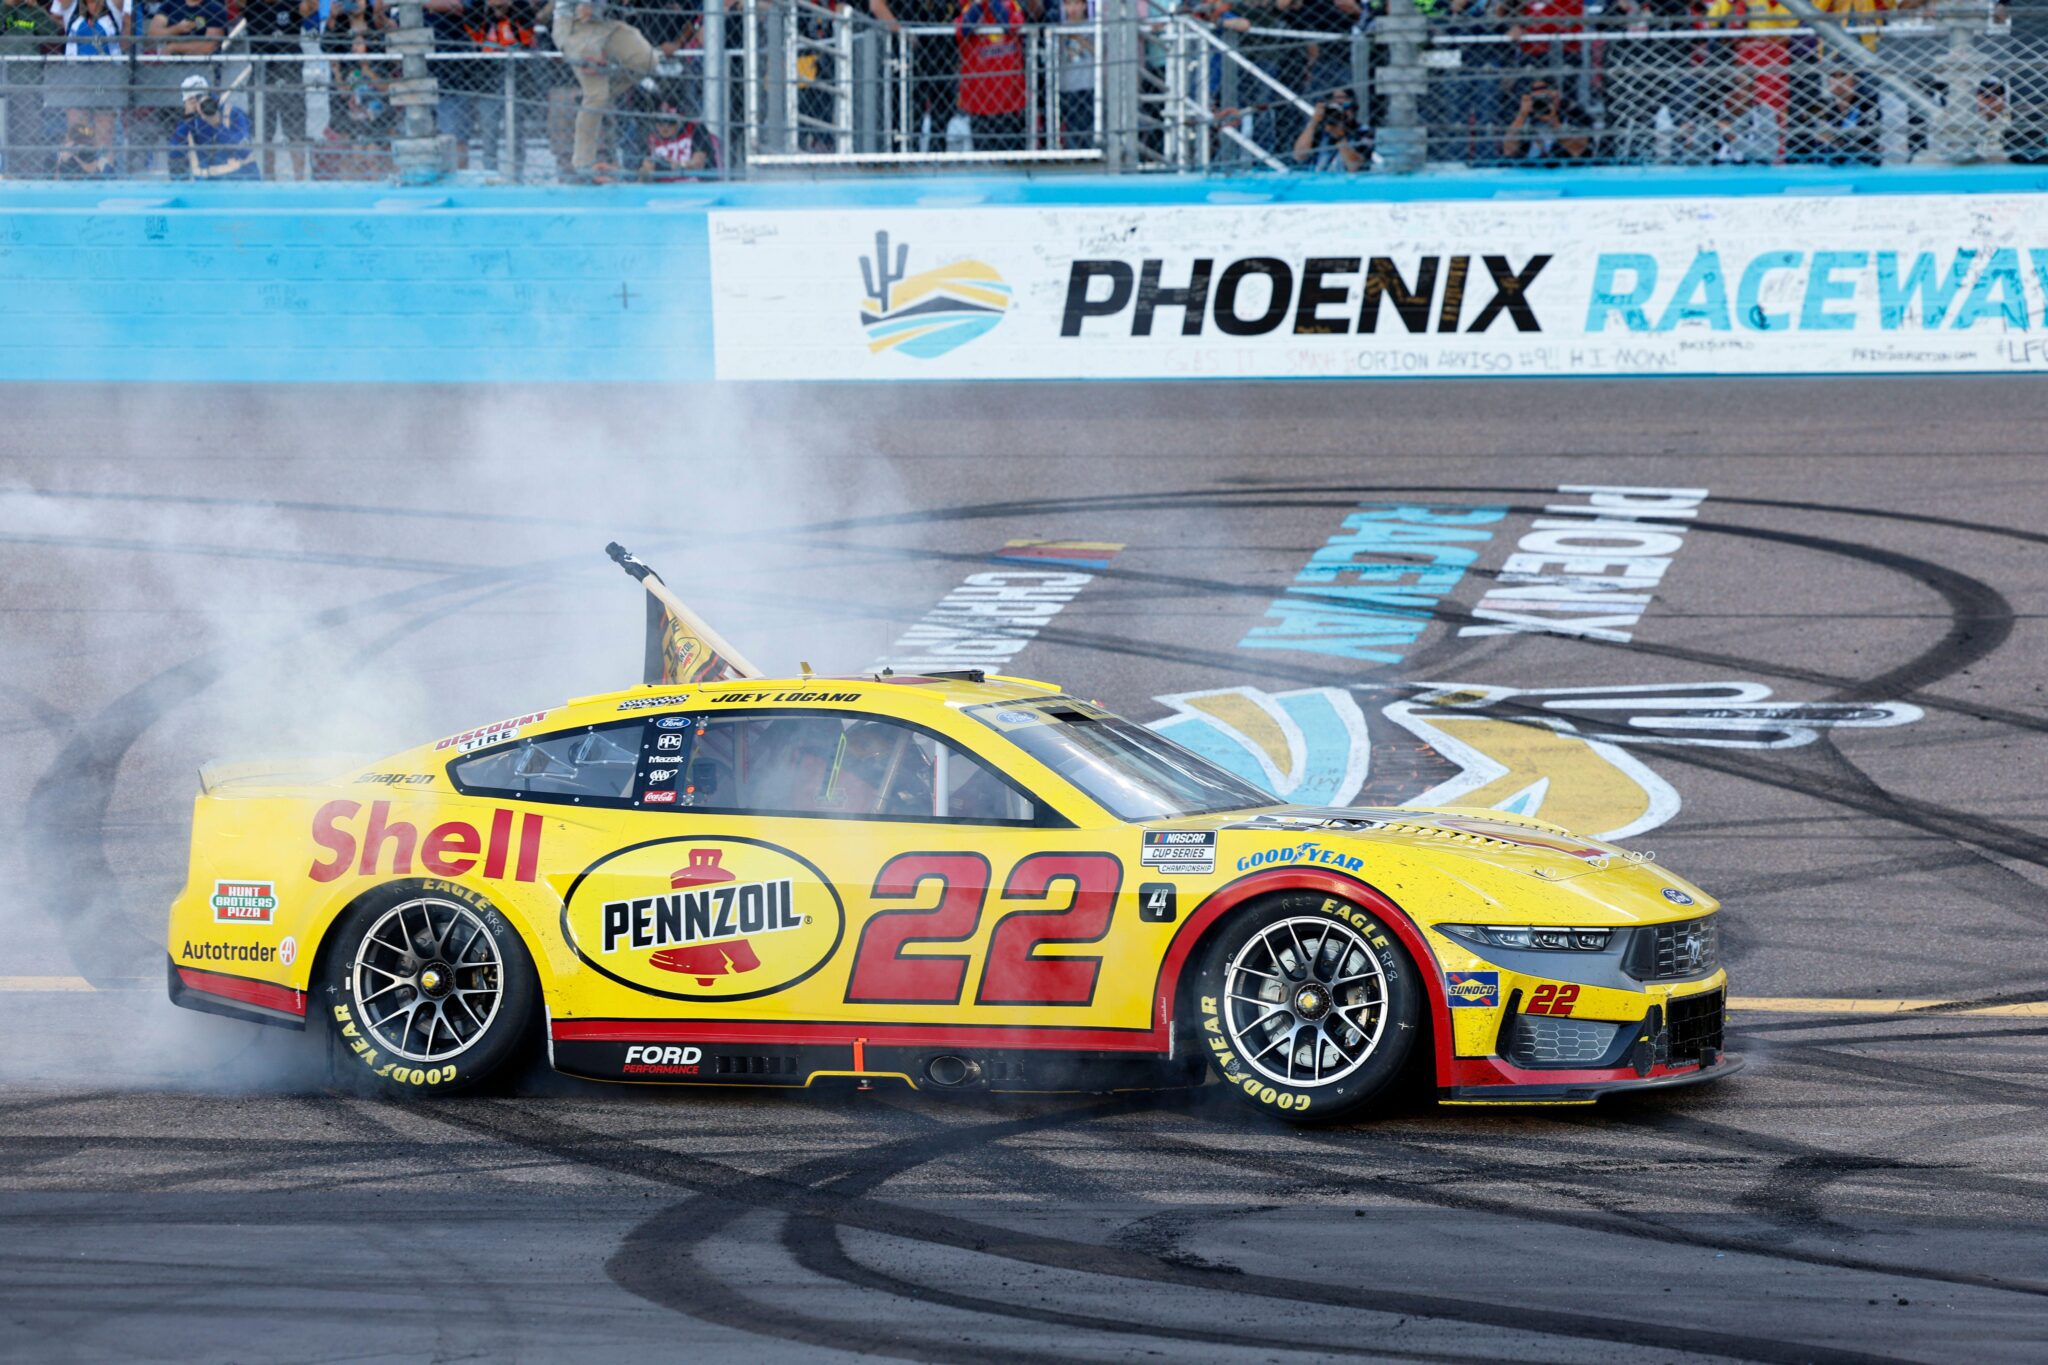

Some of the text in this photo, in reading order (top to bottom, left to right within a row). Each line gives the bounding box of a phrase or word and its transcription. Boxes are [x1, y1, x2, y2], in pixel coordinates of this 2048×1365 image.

[1060, 254, 1554, 337] PHOENIX
[1358, 350, 1429, 370] ORION
[1457, 485, 1709, 643] PHOENIX
[1237, 502, 1510, 664] RACEWAY
[711, 692, 863, 703] JOEY LOGANO
[435, 711, 548, 751] DISCOUNT
[464, 730, 512, 750] TIRE
[659, 735, 681, 749] PPG
[648, 755, 684, 764] Mazak
[644, 792, 676, 803] Coca-Cola
[308, 799, 544, 883] Shell
[1166, 833, 1206, 844] NASCAR
[1152, 848, 1206, 859] CUP SERIES
[1236, 842, 1365, 872] GOODYEAR
[1161, 865, 1212, 873] CHAMPIONSHIP
[228, 886, 261, 897] HUNT
[422, 878, 493, 912] EAGLE
[215, 896, 273, 908] BROTHERS
[1147, 888, 1168, 917] 4
[227, 907, 261, 918] PIZZA
[604, 879, 802, 952] PENNZOIL
[842, 851, 1125, 1007] 22
[1320, 898, 1390, 950] EAGLE
[182, 940, 277, 962] Autotrader
[1380, 950, 1399, 983] RF8
[1449, 984, 1497, 996] SUNOCO
[1525, 984, 1581, 1015] 22
[624, 1046, 702, 1065] FORD
[622, 1064, 700, 1075] PERFORMANCE
